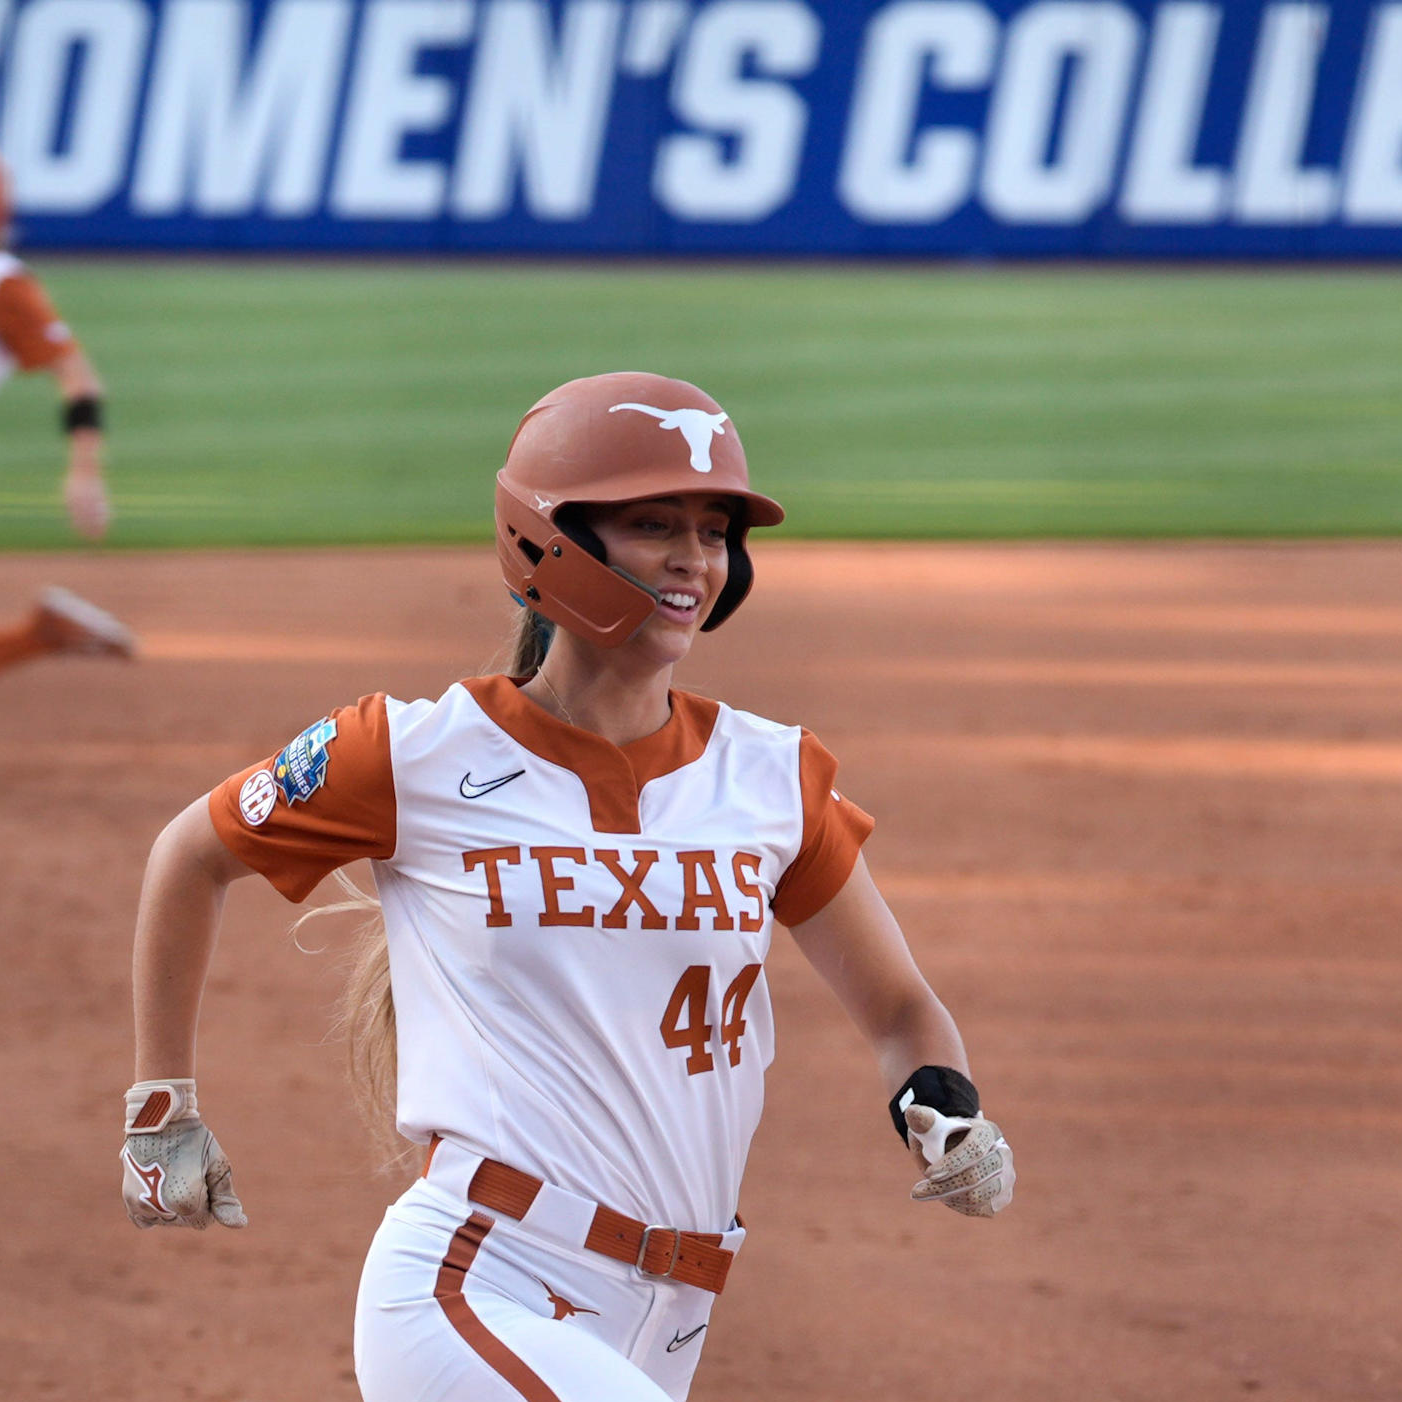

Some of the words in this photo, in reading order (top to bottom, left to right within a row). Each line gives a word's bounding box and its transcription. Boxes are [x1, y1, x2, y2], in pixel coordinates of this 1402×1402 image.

[240, 772, 276, 822] SEC
[461, 845, 765, 933] TEXAS
[659, 963, 763, 1077] 44
